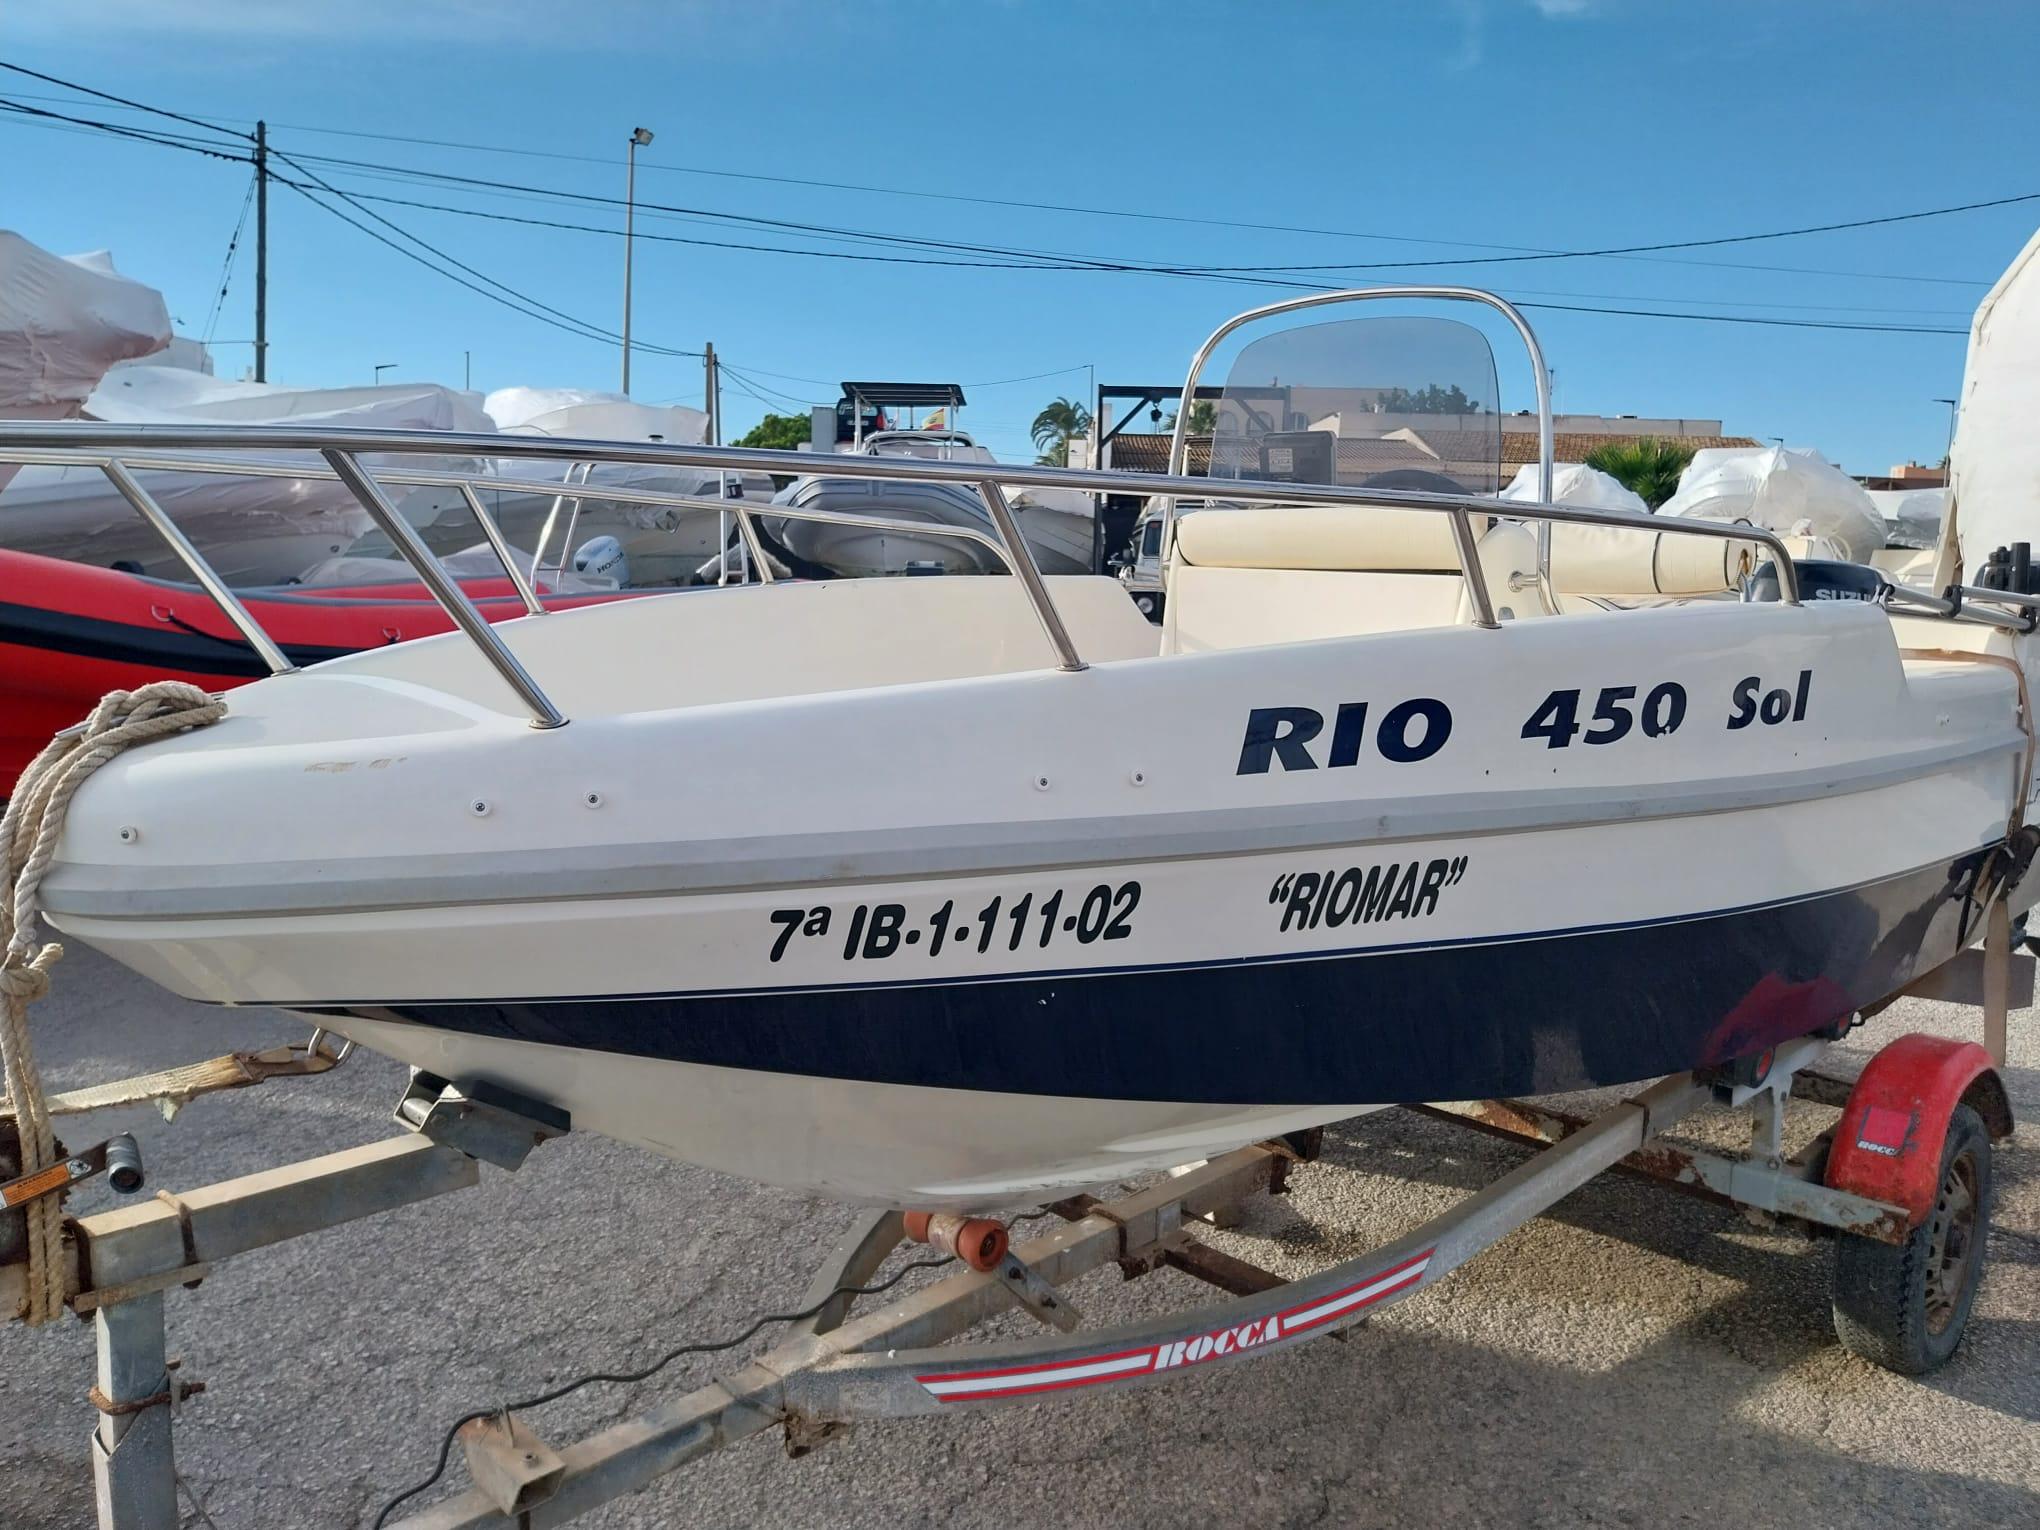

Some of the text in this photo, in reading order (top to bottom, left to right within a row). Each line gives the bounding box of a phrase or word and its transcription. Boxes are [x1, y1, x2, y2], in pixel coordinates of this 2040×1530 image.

[1236, 670, 1812, 775] RIO 450 Sol
[1269, 855, 1469, 932] “RIOMAR”
[1154, 1316, 1279, 1370] ROCCA
